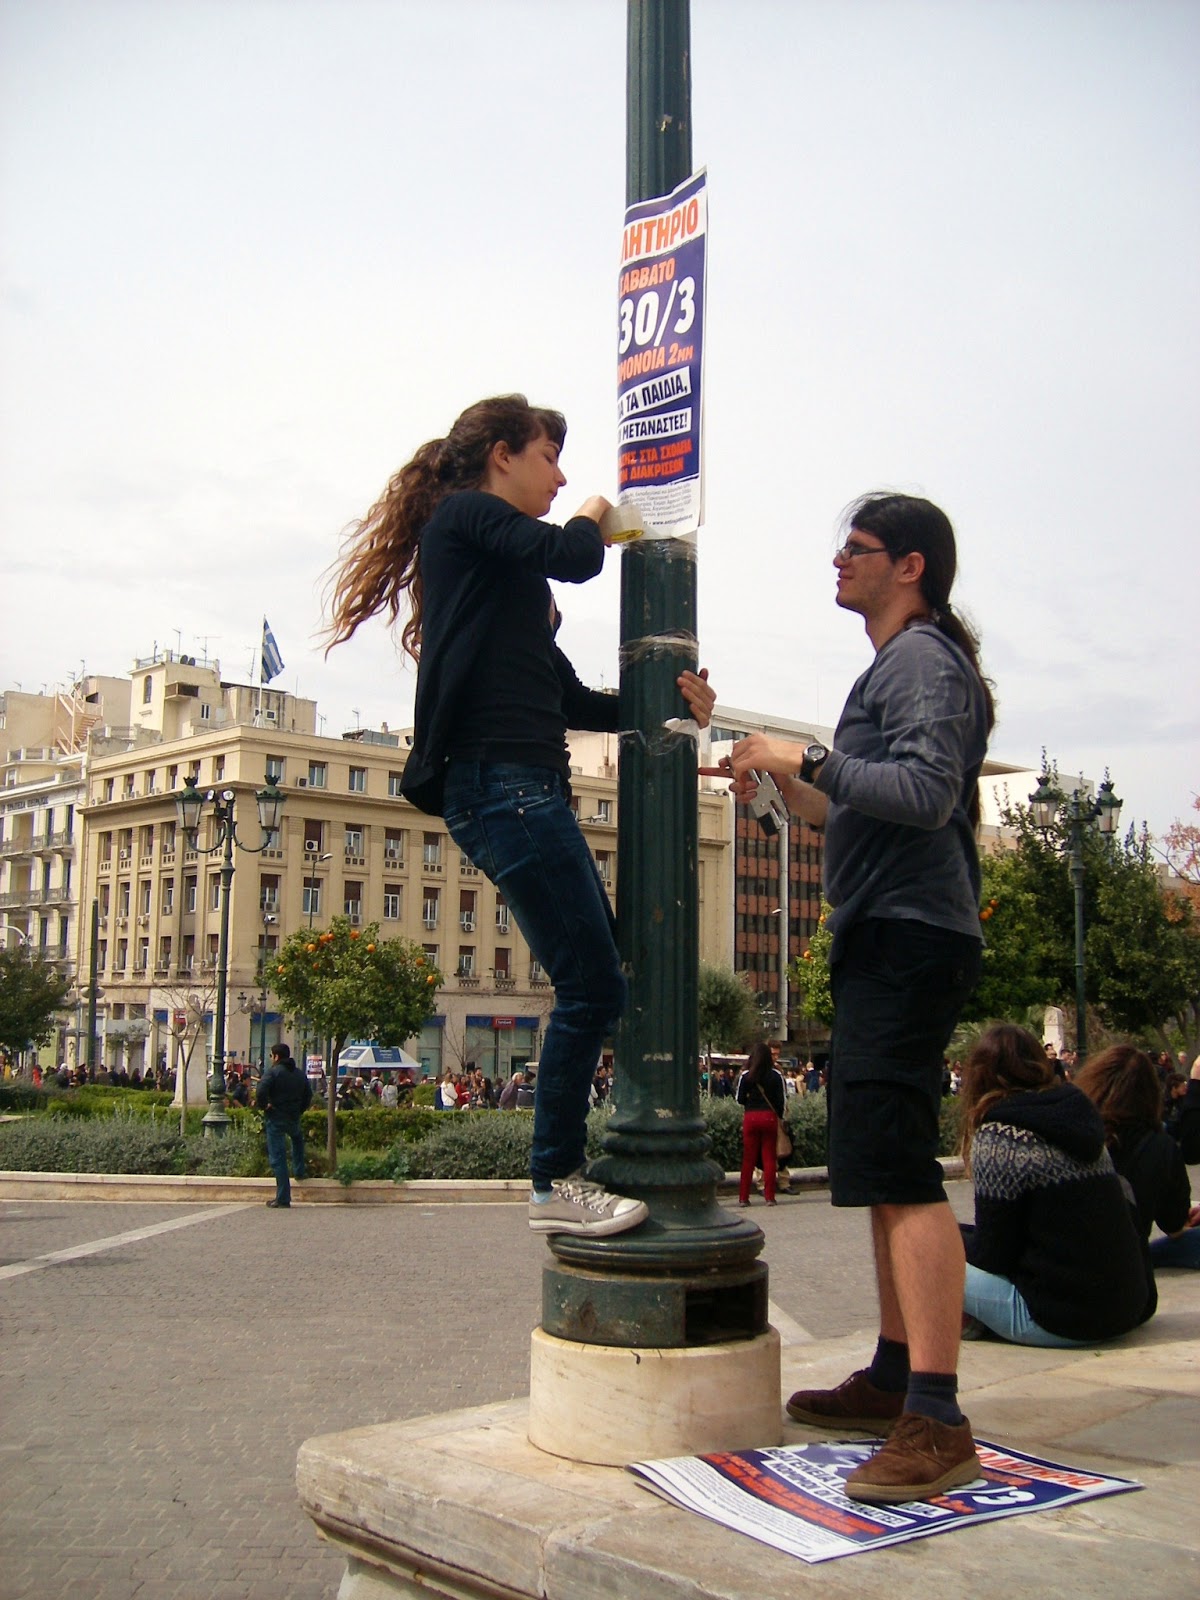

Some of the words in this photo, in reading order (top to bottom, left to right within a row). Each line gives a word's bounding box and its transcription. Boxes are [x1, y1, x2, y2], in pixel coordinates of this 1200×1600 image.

[618, 276, 696, 354] 30/3
[626, 391, 639, 413] ΤΑ
[641, 374, 688, 407] ΠΑΙΔΙΑ,
[623, 412, 688, 441] ΜΕΤΑΝΑΣΤΕΣ!
